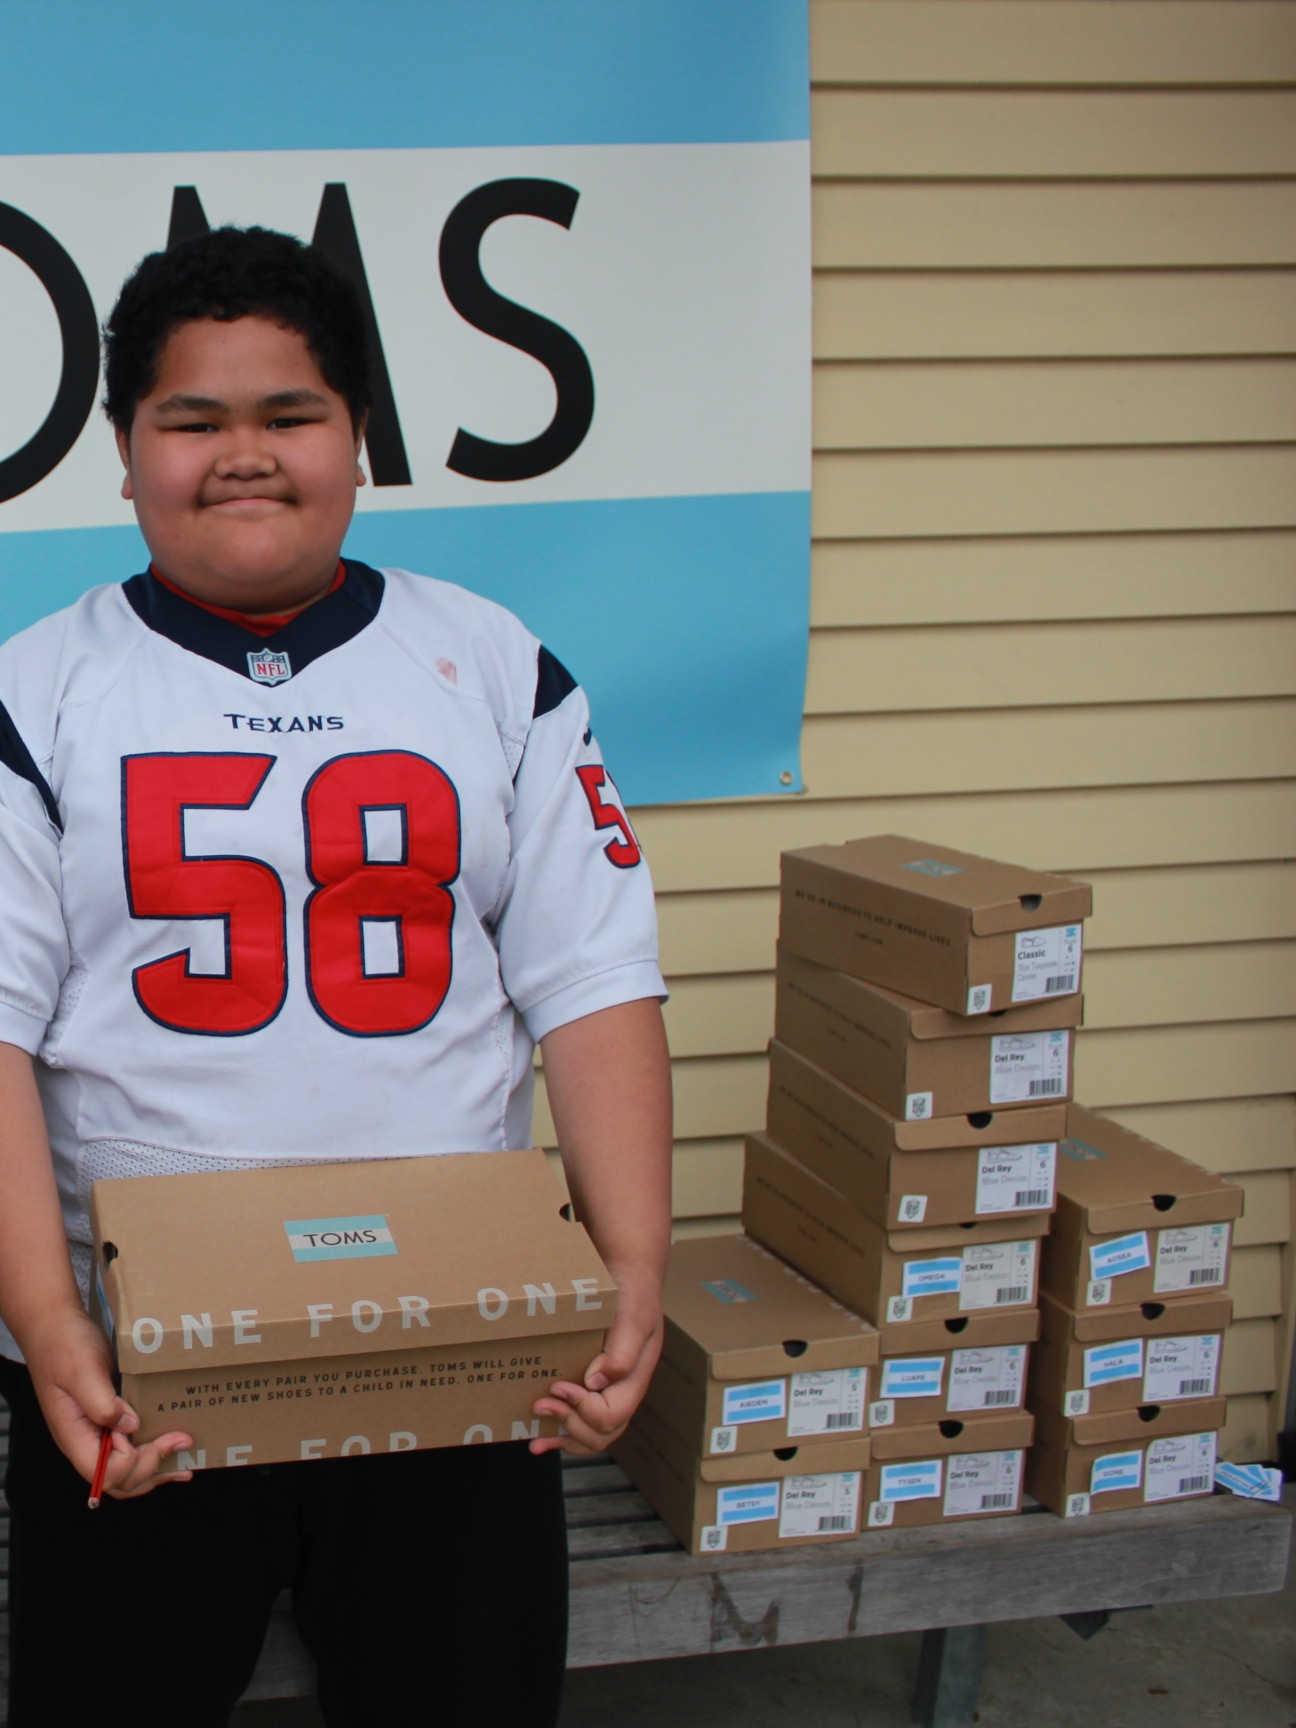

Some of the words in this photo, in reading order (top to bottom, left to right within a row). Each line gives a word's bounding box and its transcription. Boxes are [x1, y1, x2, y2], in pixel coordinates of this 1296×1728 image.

[256, 663, 285, 677] NFL
[223, 713, 344, 733] TEXANS
[120, 750, 461, 1038] 58
[874, 914, 892, 927] HELP
[894, 919, 927, 939] IMPROVE
[929, 934, 951, 947] LIVES
[1018, 948, 1046, 960] Classic
[303, 1229, 378, 1248] TOMS
[132, 1309, 262, 1354] ONE
[307, 1295, 431, 1338] FOR
[477, 1278, 603, 1321] ONE
[185, 1384, 219, 1395] WITH
[226, 1380, 269, 1392] EVERY
[275, 1377, 307, 1387] PAIR
[313, 1374, 339, 1384] YOU
[430, 1363, 466, 1374] TOMS
[472, 1360, 503, 1371] WILL
[510, 1356, 541, 1367] GIVE
[157, 1403, 164, 1412] A
[170, 1400, 202, 1411] PAIR
[208, 1398, 224, 1408] OF
[230, 1395, 260, 1406] NEW
[266, 1390, 312, 1402] SHOES
[319, 1388, 334, 1398] TO
[339, 1387, 347, 1396] A
[352, 1383, 393, 1395] CHILD
[399, 1381, 413, 1391] IN
[466, 1374, 493, 1385] ONE
[499, 1372, 525, 1382] FOR
[177, 1445, 253, 1471] NE
